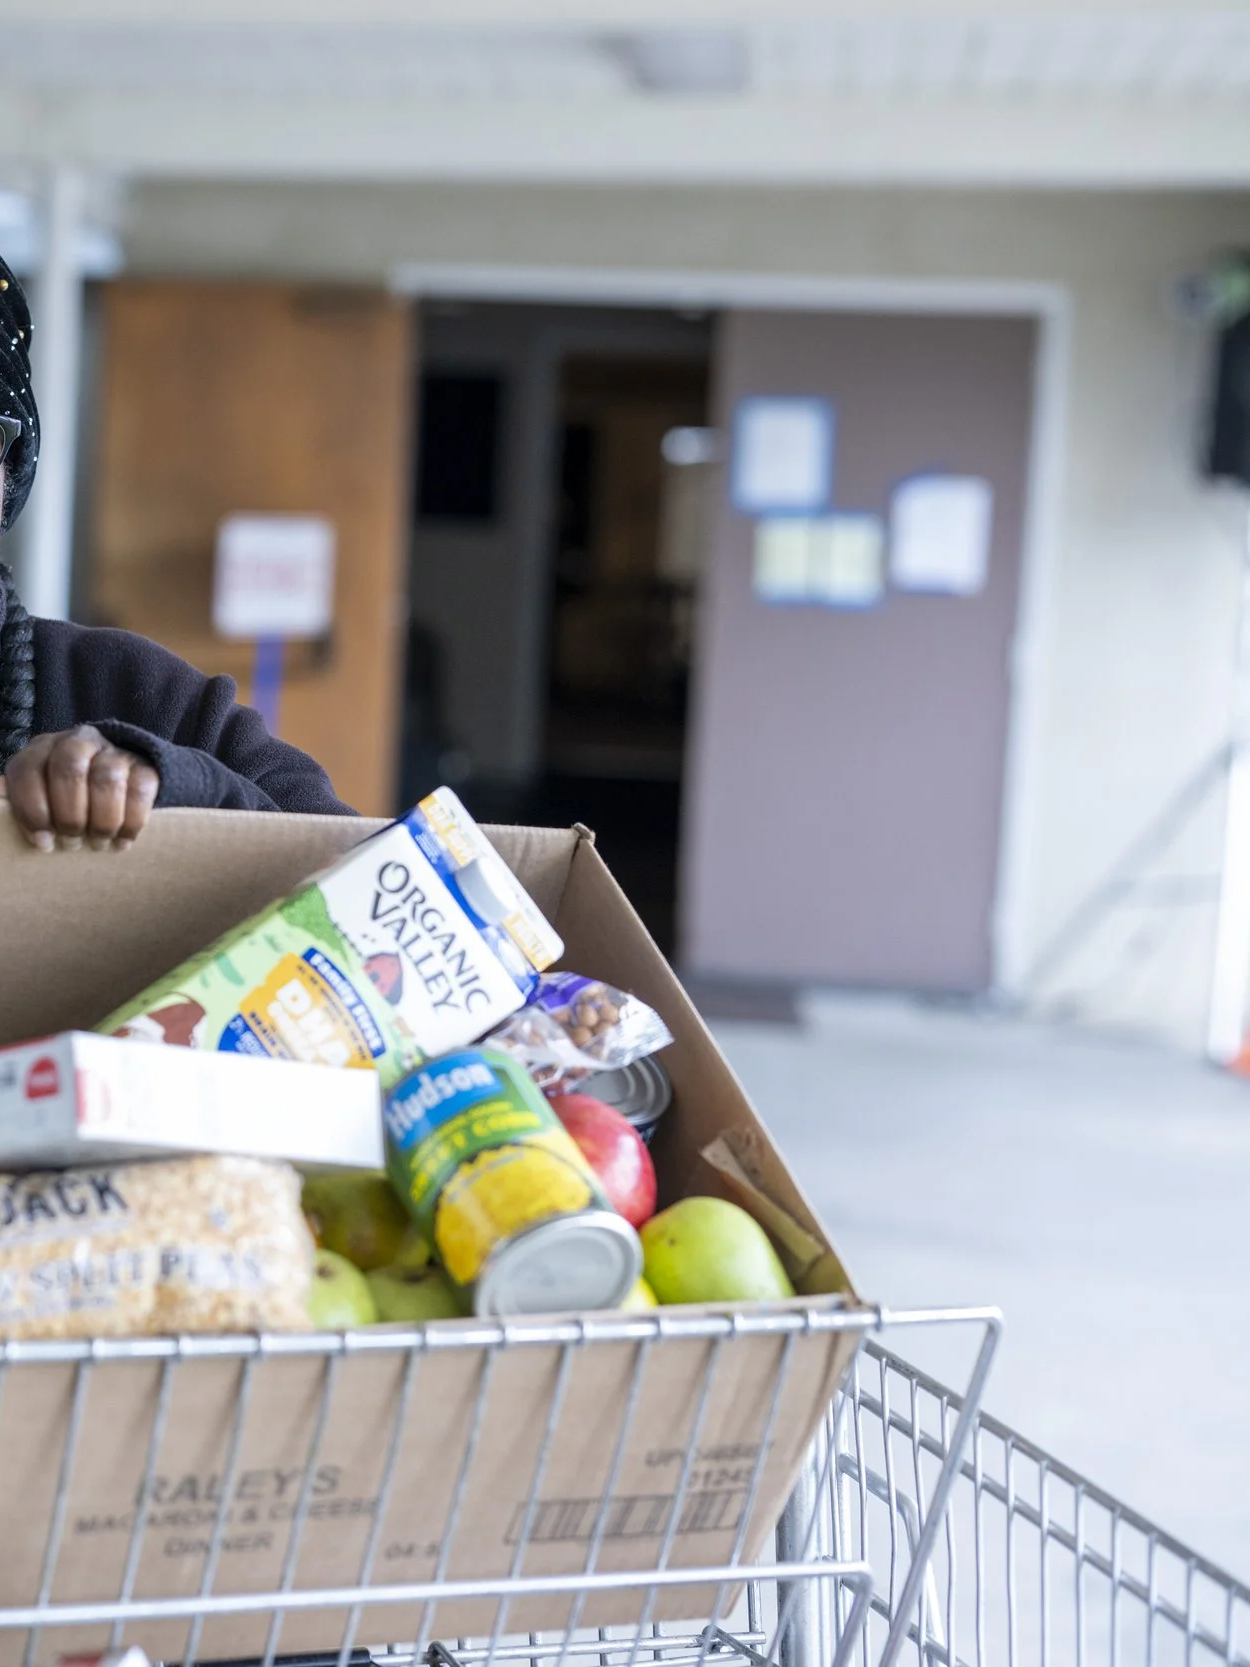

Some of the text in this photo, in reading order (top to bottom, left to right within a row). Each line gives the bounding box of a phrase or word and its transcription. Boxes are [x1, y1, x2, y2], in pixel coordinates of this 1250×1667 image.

[370, 890, 460, 1015] VALLEY
[378, 861, 491, 1013] ORGANIC
[387, 1062, 496, 1141] Hudson
[134, 1464, 343, 1506] RALEY'S
[267, 1495, 382, 1523] CEESE
